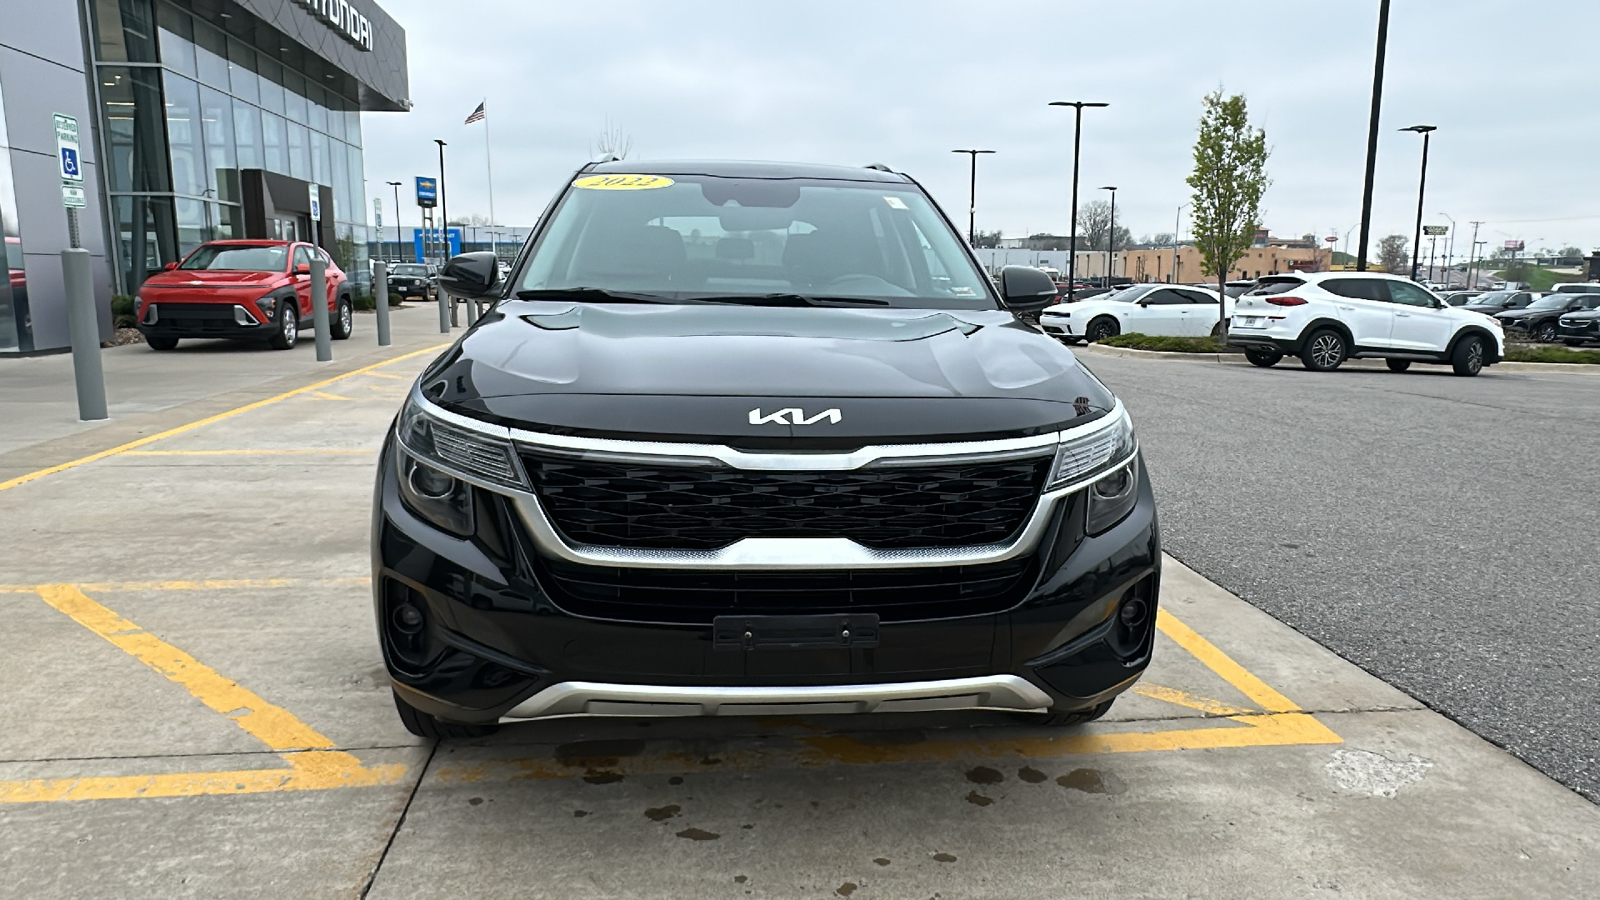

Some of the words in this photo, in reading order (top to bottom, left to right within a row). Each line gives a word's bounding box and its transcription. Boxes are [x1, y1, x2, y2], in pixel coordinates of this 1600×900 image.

[306, 0, 373, 52] YUNDAI
[57, 131, 78, 143] PARKING
[586, 177, 659, 187] 2022
[748, 406, 842, 425] KIA
